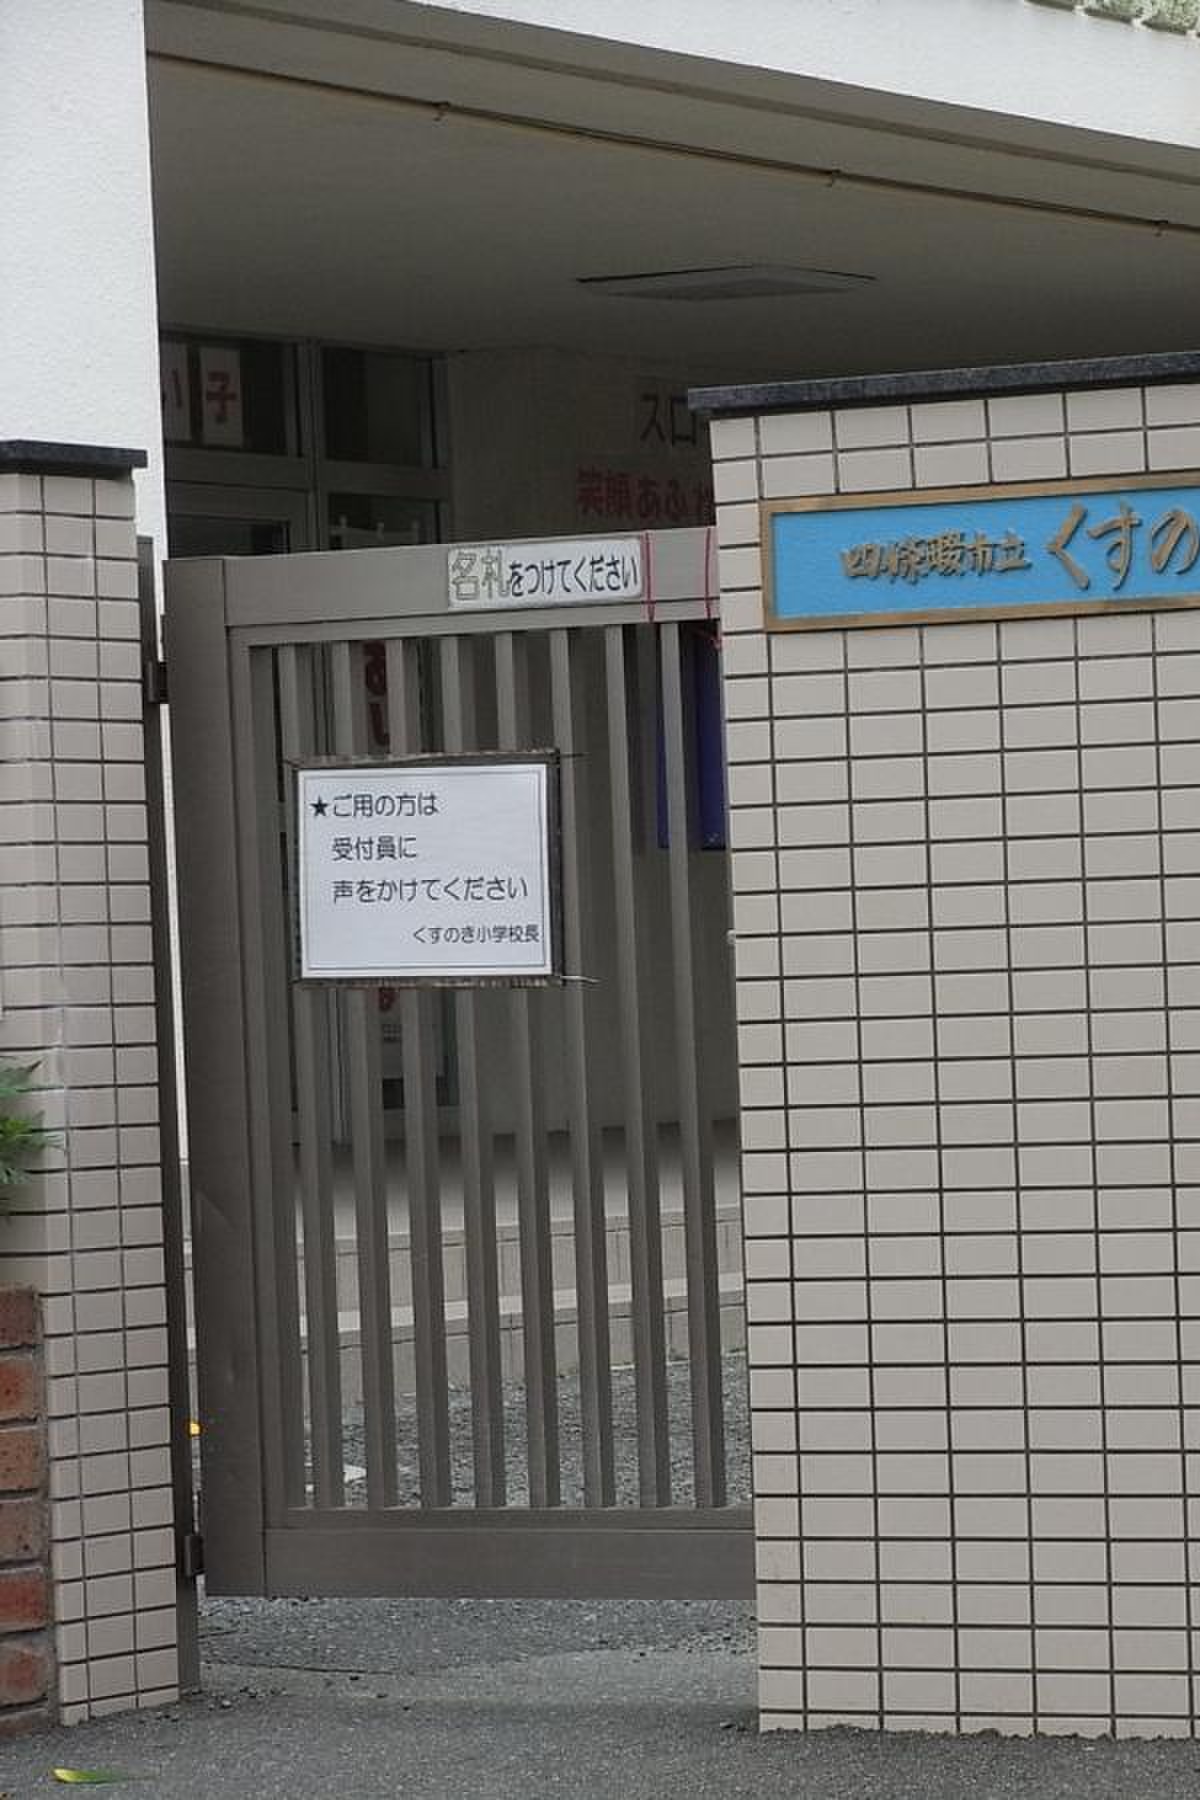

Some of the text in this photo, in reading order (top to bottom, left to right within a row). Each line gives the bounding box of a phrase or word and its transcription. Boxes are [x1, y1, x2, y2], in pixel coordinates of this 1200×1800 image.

[452, 549, 638, 601] 名札をつけてください
[331, 836, 418, 861] 受付員に
[332, 877, 528, 904] 声をかけてください
[412, 924, 541, 944] くすのき小学校長
